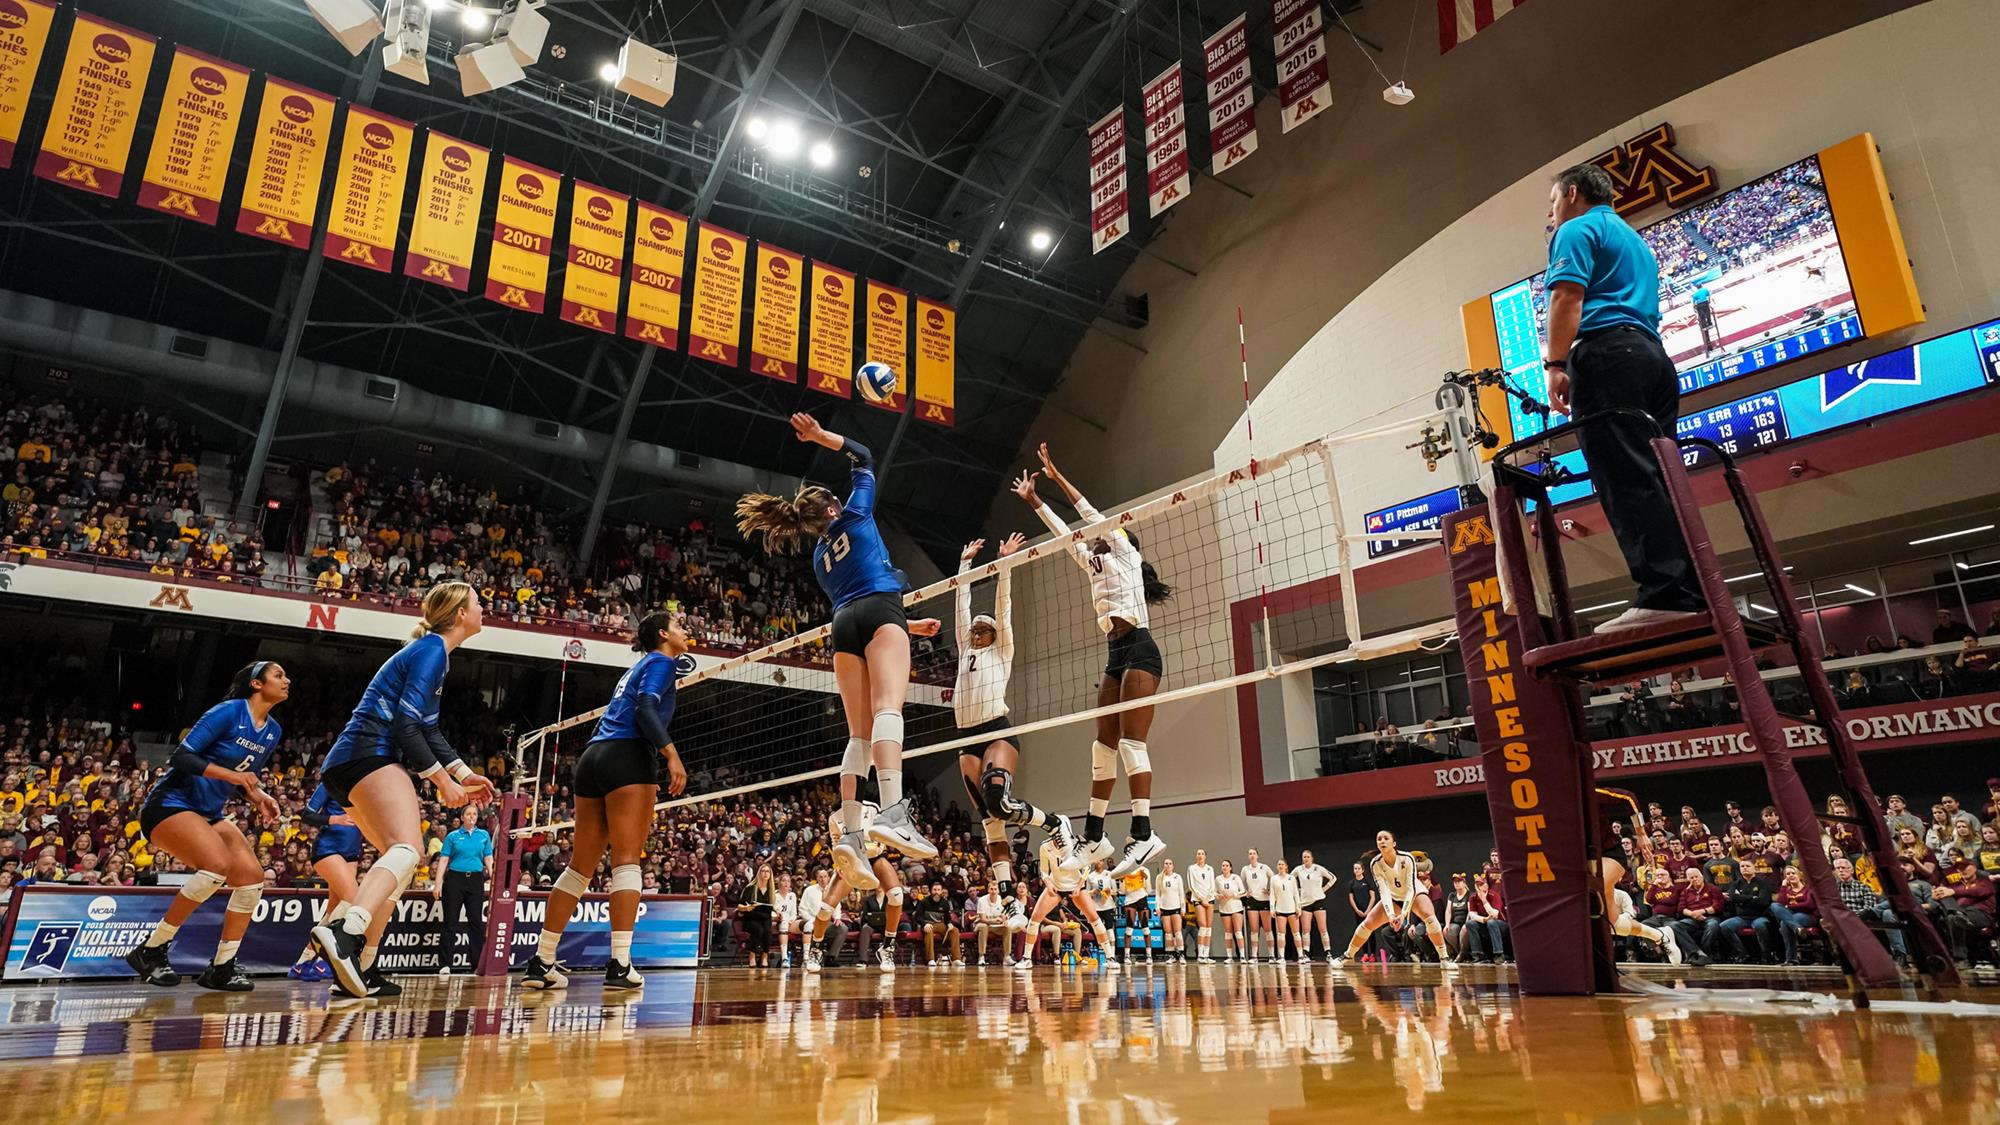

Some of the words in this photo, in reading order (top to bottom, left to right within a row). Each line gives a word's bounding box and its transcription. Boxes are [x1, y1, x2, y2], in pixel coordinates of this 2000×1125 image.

[1282, 15, 1314, 47] 2014
[9, 34, 24, 44] 10
[1208, 44, 1224, 64] BIG
[1226, 28, 1245, 49] TEN
[96, 43, 129, 60] NCAA
[1208, 41, 1246, 73] CHAMPIONS
[1285, 44, 1317, 76] 2016
[88, 58, 110, 71] TOP
[114, 67, 128, 79] 10
[79, 66, 132, 89] FINISHES
[193, 76, 226, 92] NCAA
[1214, 66, 1244, 96] 2006
[78, 78, 102, 92] 1949
[1146, 89, 1162, 108] BIG
[1163, 76, 1180, 97] TEN
[76, 87, 100, 100] 1953
[186, 91, 208, 104] TOP
[211, 100, 225, 110] 10
[73, 96, 98, 108] 1957
[1216, 94, 1245, 122] 2013
[71, 105, 95, 118] 1959
[177, 98, 228, 121] FINISHES
[284, 105, 313, 119] NCAA
[69, 114, 92, 128] 1963
[178, 112, 202, 124] 1979
[1152, 112, 1176, 137] 1991
[66, 124, 90, 137] 1976
[176, 120, 200, 132] 1989
[277, 120, 297, 131] TOP
[301, 127, 312, 137] 10
[63, 132, 88, 146] 1977
[174, 129, 197, 141] 1990
[270, 127, 316, 147] FINISHES
[366, 132, 392, 146] NCAA
[1092, 134, 1105, 148] BIG
[1106, 120, 1121, 138] TEN
[172, 138, 194, 149] 1991
[271, 139, 292, 151] 1999
[61, 145, 109, 165] WRESTLING
[169, 146, 192, 158] 1993
[268, 147, 290, 159] 2000
[360, 146, 378, 158] TOP
[382, 154, 393, 163] 10
[1153, 138, 1180, 164] 1998
[167, 155, 191, 167] 1997
[266, 156, 288, 167] 2001
[353, 153, 397, 174] FINISHES
[445, 155, 470, 170] NCAA
[1095, 153, 1119, 177] 1988
[165, 164, 189, 176] 1998
[265, 164, 287, 176] 2002
[440, 169, 456, 180] TOP
[460, 176, 470, 185] 10
[161, 176, 207, 193] WRESTLING
[263, 173, 285, 184] 2003
[352, 174, 372, 185] 2007
[433, 175, 474, 195] FINISHES
[262, 182, 283, 194] 2004
[432, 187, 452, 198] 2014
[518, 183, 543, 196] NCAA
[1096, 179, 1120, 203] 1989
[260, 190, 282, 202] 2005
[348, 190, 369, 202] 2010
[431, 195, 450, 206] 2015
[258, 202, 300, 218] WRESTLING
[347, 198, 367, 210] 2011
[430, 203, 449, 214] 2017
[502, 194, 554, 217] CHAMPIONS
[345, 206, 366, 218] 2012
[428, 211, 448, 222] 2019
[590, 205, 612, 218] NCAA
[344, 215, 365, 227] 2013
[574, 216, 624, 238] CHAMPIONS
[343, 227, 382, 242] WRESTLING
[652, 225, 672, 238] NCAA
[503, 228, 542, 251] 2001
[424, 246, 460, 261] WRESTLING
[638, 237, 683, 258] CHAMPIONS
[713, 246, 732, 258] NCAA
[575, 250, 614, 273] 2002
[702, 256, 740, 274] CHAMPION
[502, 264, 536, 278] WRESTLING
[640, 269, 675, 290] 2007
[762, 276, 797, 292] CHAMPION
[576, 284, 608, 298] WRESTLING
[640, 302, 670, 315] WRESTLING
[816, 294, 849, 310] CHAMPION
[872, 312, 902, 326] CHAMPION
[921, 328, 951, 341] CHAMPION
[1722, 356, 1744, 368] MINN
[49, 368, 68, 378] 203
[1707, 374, 1714, 382] 3
[1724, 366, 1739, 377] CRE
[1679, 377, 1694, 390] 11
[1676, 417, 1702, 434] ILLS
[1708, 408, 1732, 423] ERR
[1738, 396, 1775, 414] HIT%
[1719, 424, 1733, 438] 13
[1750, 412, 1776, 430] .163
[1683, 451, 1699, 466] 27
[1722, 440, 1737, 454] 15
[1754, 429, 1777, 447] .121
[1386, 512, 1394, 523] 21
[1396, 504, 1428, 520] Pittman
[823, 532, 850, 573] 19
[307, 603, 339, 630] N
[1468, 576, 1556, 883] MINNESOTA
[1622, 732, 1757, 766] ATHLETIC
[235, 755, 255, 772] 6
[1394, 877, 1401, 888] 6
[90, 907, 116, 916] NCAA
[252, 899, 302, 923] 019
[384, 934, 420, 947] AND
[495, 922, 507, 957] Senoh
[72, 946, 136, 958] CHAMPION
